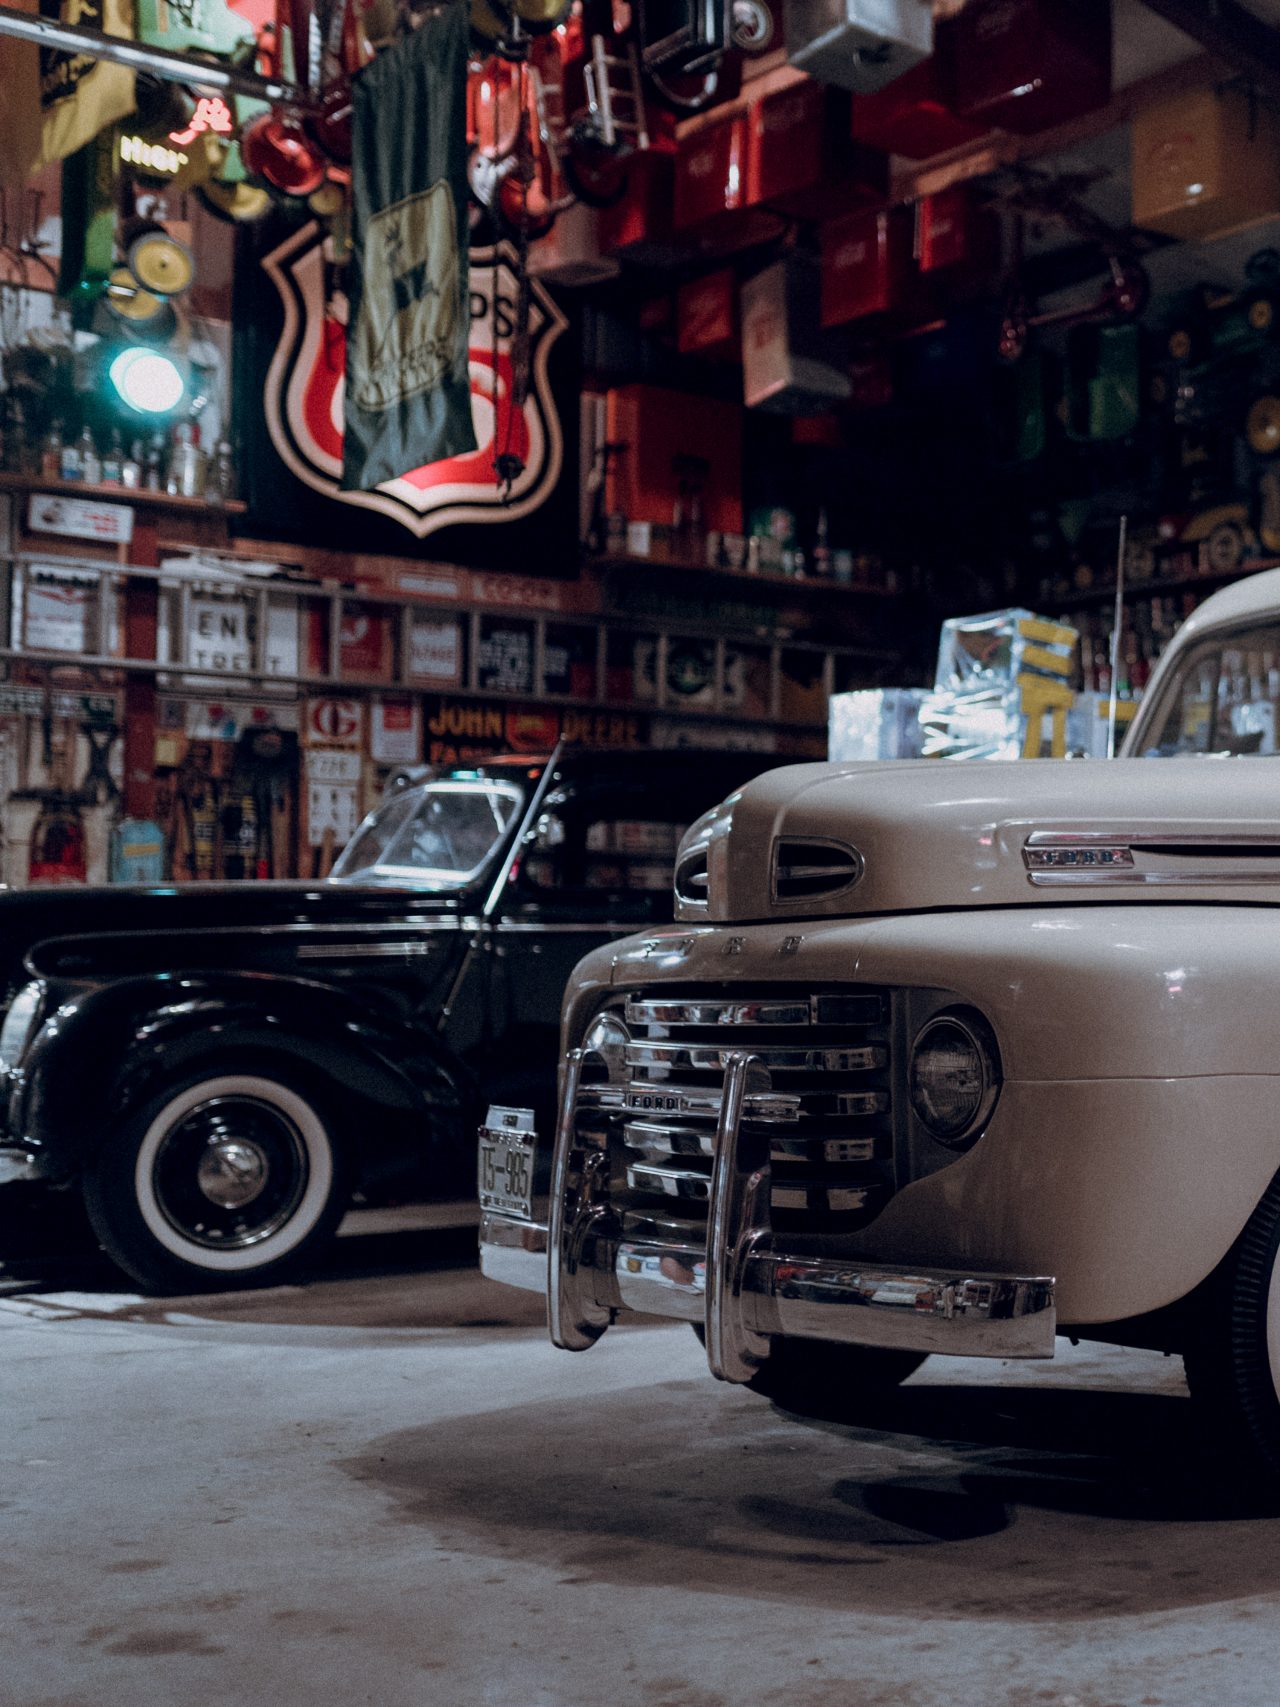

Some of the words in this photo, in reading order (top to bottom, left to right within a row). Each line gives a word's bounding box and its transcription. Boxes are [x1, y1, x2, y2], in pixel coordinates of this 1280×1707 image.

[427, 702, 504, 739] JOHN
[561, 708, 644, 746] DEERE
[631, 1095, 676, 1110] FORD
